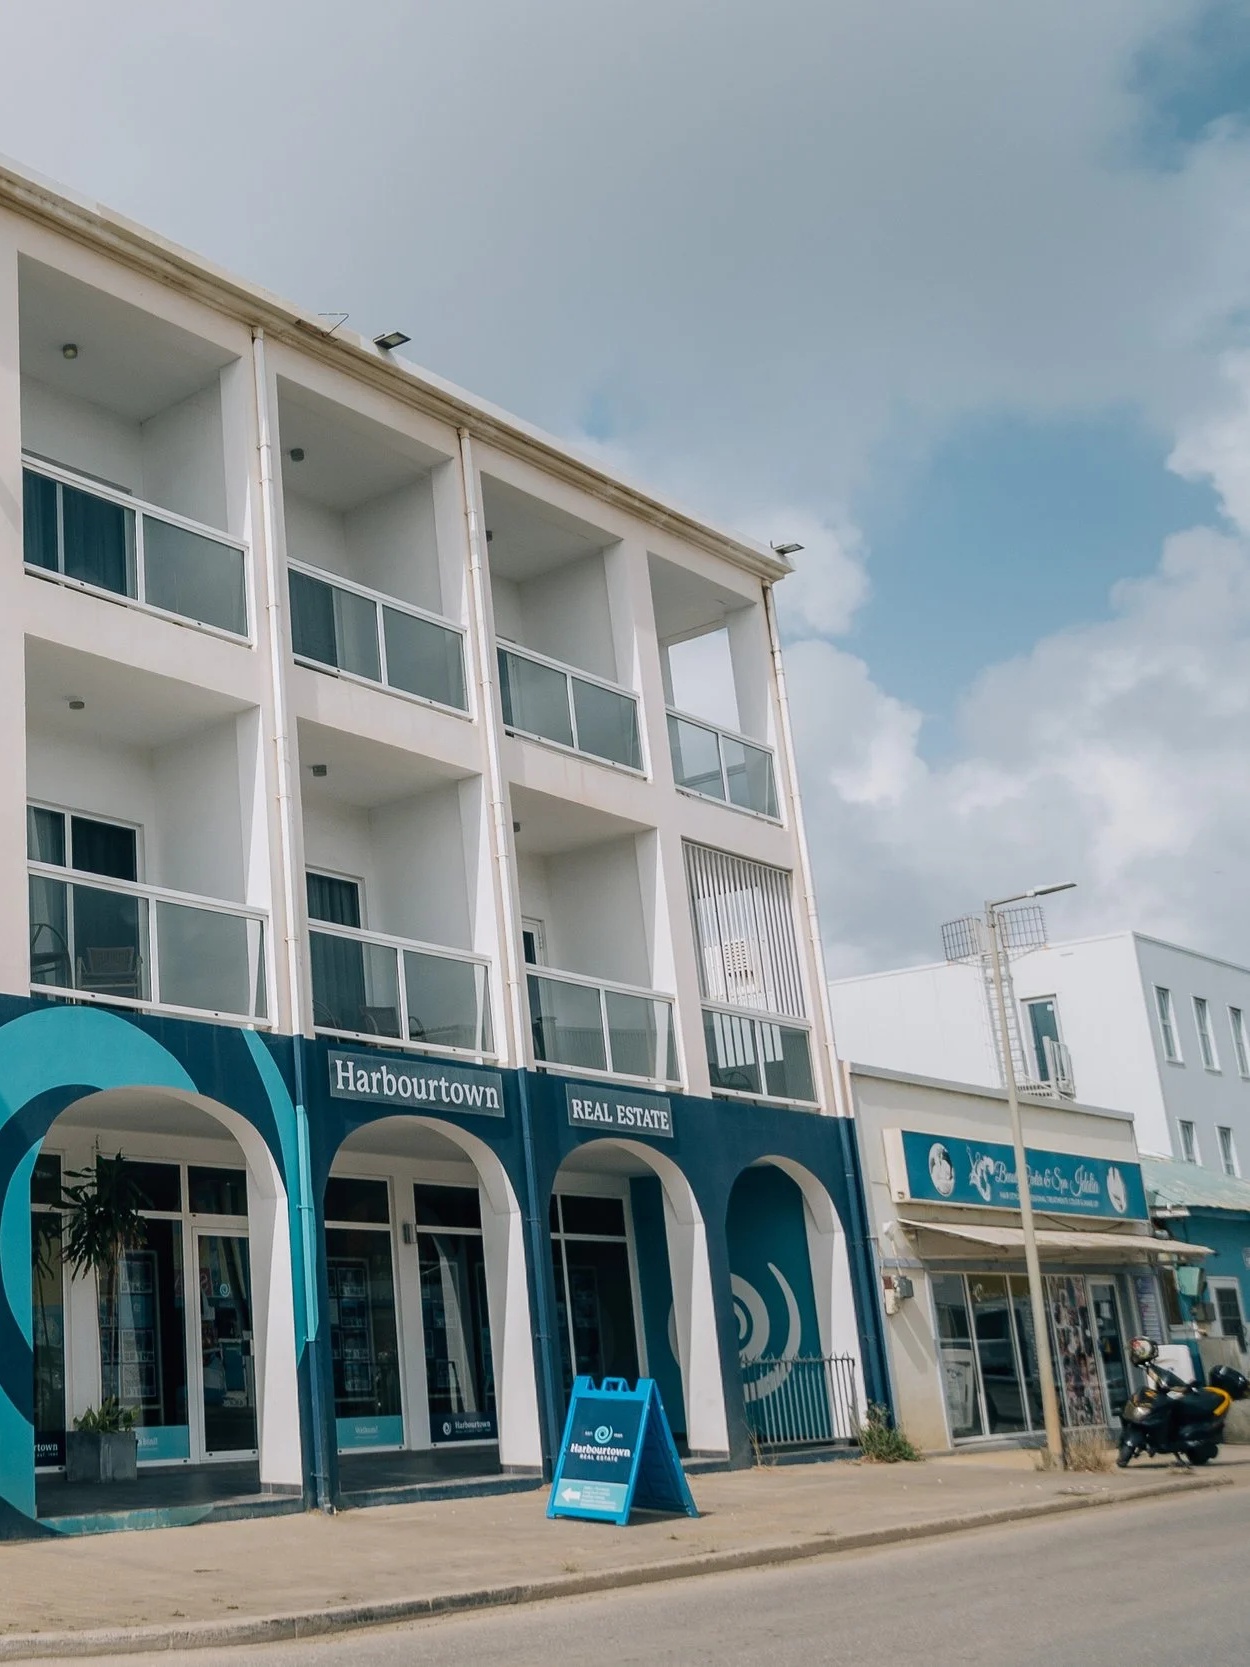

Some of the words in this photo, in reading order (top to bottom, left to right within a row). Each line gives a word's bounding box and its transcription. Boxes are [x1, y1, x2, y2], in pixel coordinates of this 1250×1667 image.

[335, 1059, 500, 1110] Harbourtown
[571, 1098, 613, 1123] REAL
[617, 1103, 670, 1130] ESTATE
[570, 1443, 631, 1457] Harbourtown
[579, 1453, 594, 1461] REAL
[596, 1454, 618, 1463] ESTATE
